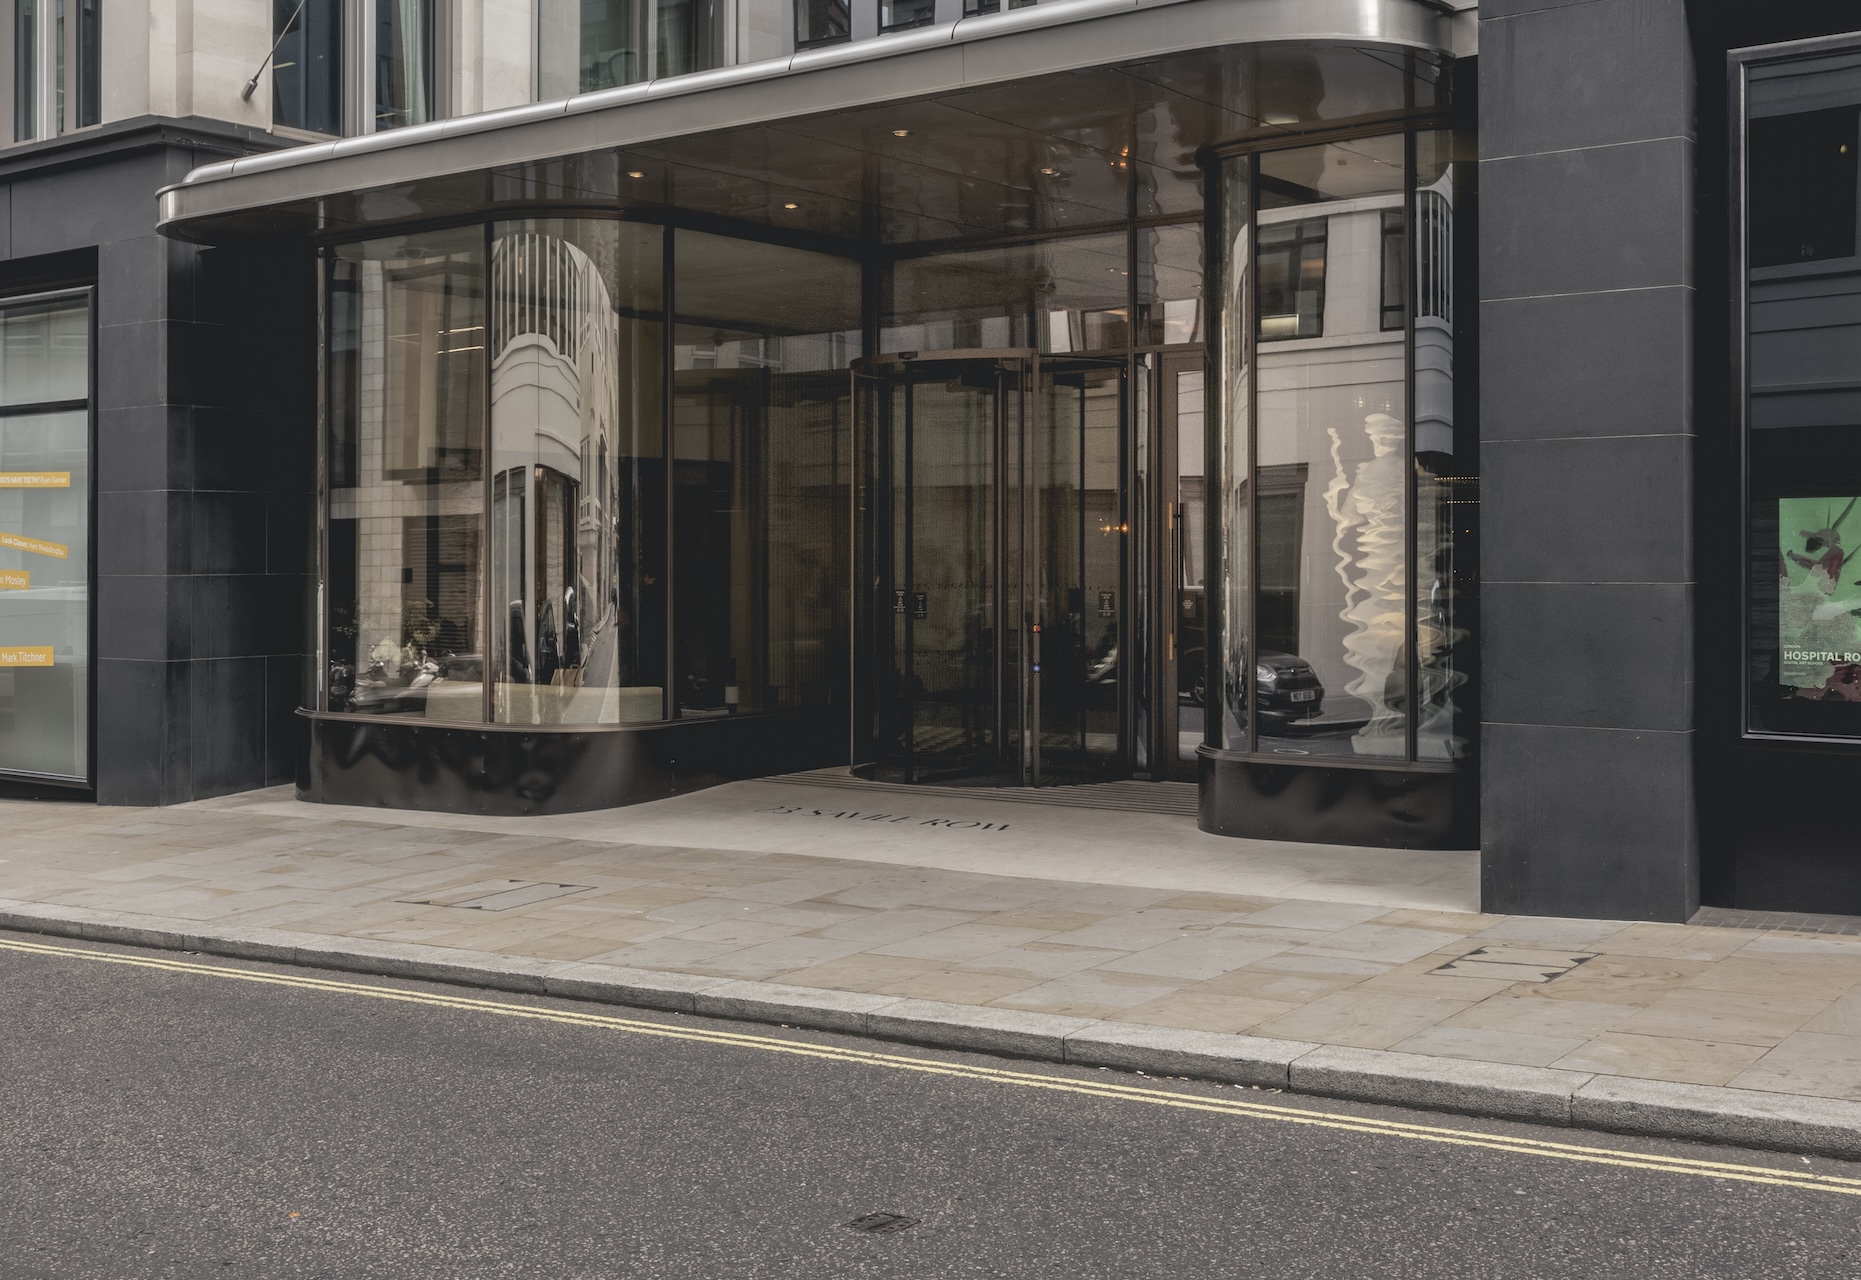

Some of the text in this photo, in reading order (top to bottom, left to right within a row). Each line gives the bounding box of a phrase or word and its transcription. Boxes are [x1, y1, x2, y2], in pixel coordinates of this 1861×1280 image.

[11, 476, 23, 484] HAVE
[2, 536, 13, 545] Look
[29, 542, 38, 550] Ken
[5, 575, 26, 588] Mosley
[2, 651, 46, 663] Mark Titchner
[1784, 651, 1861, 662] HOSPITAL RO
[753, 805, 1026, 832] 23 SAVILE ROW
